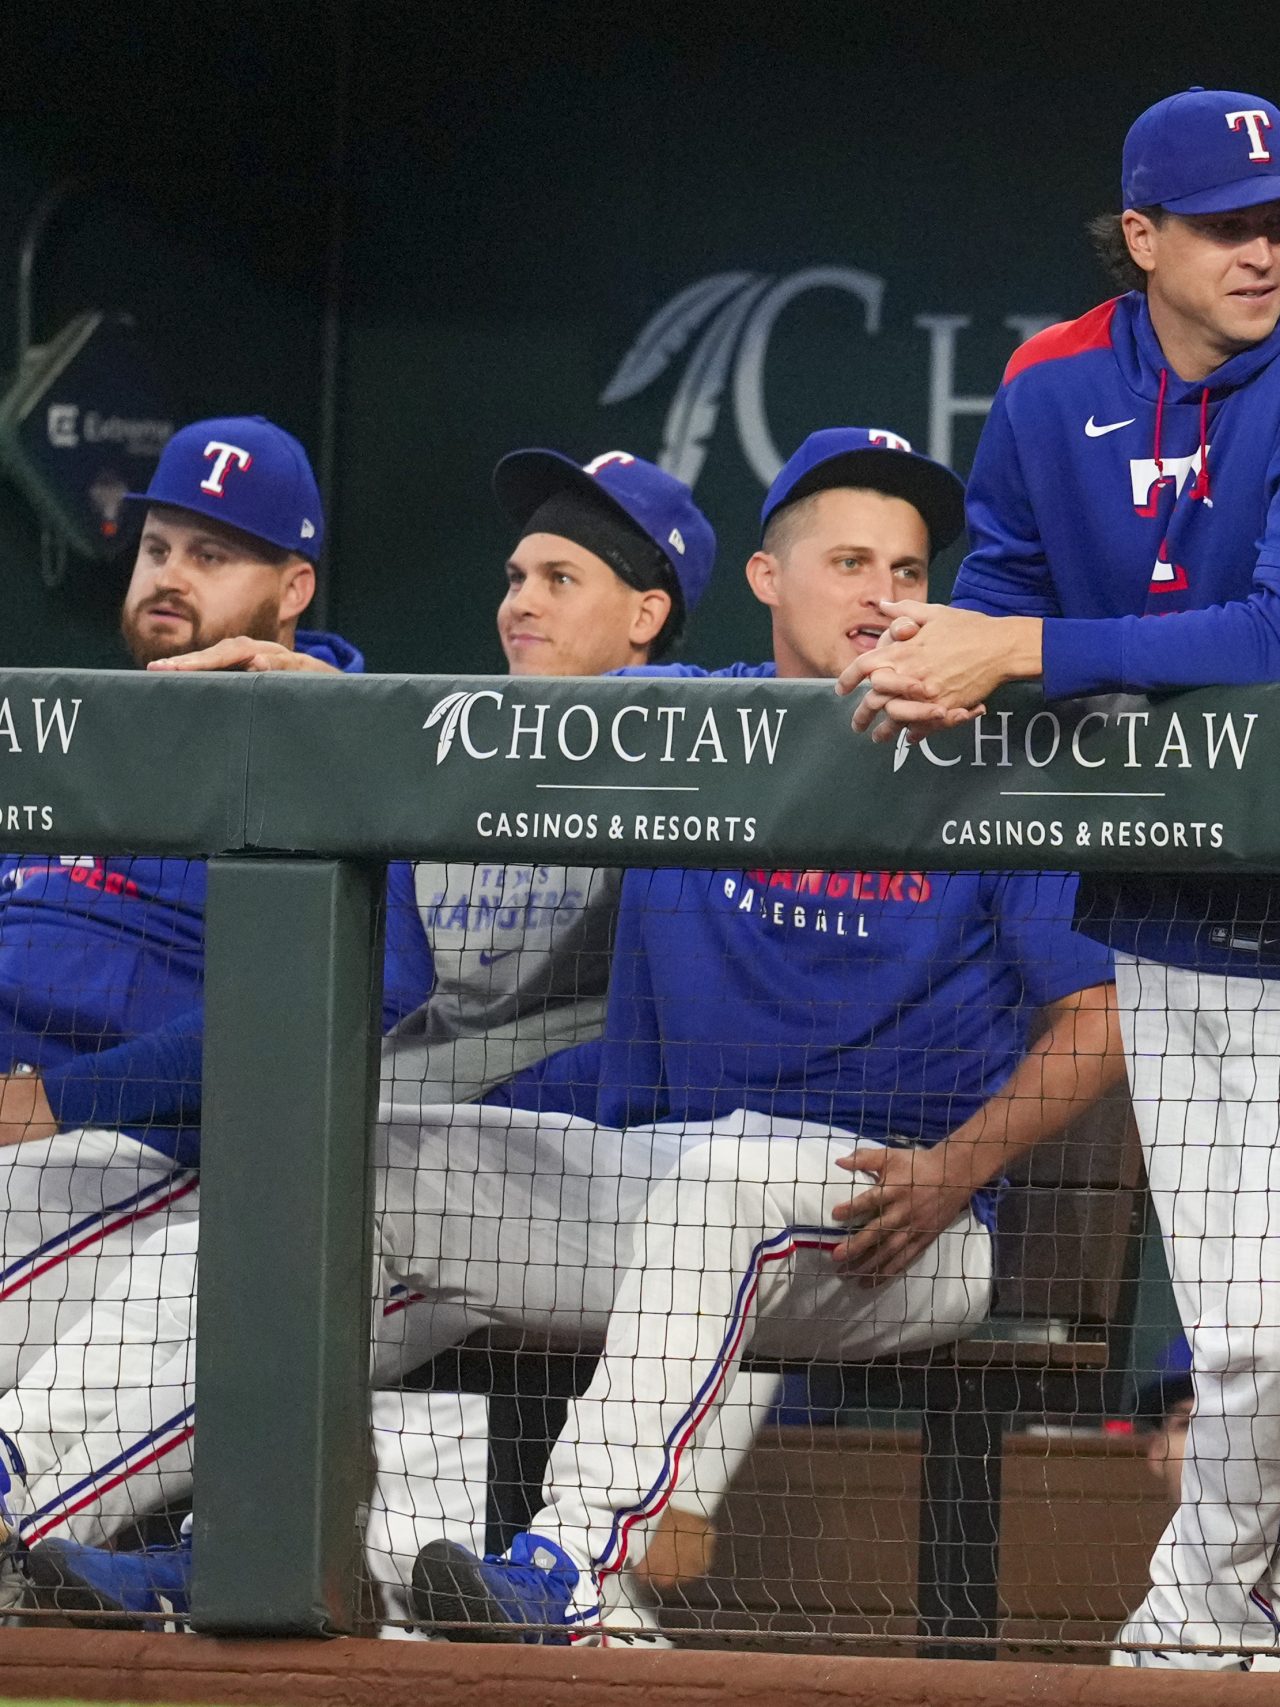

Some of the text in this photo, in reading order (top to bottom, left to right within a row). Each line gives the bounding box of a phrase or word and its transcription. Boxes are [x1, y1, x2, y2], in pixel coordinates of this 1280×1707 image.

[1224, 109, 1272, 163] T
[201, 440, 252, 498] T
[459, 690, 787, 764] CHOCTAW
[0, 805, 52, 831] RTS
[477, 812, 756, 842] CASINOS & RESORTS
[942, 819, 1223, 848] CASINOS & RESORTS
